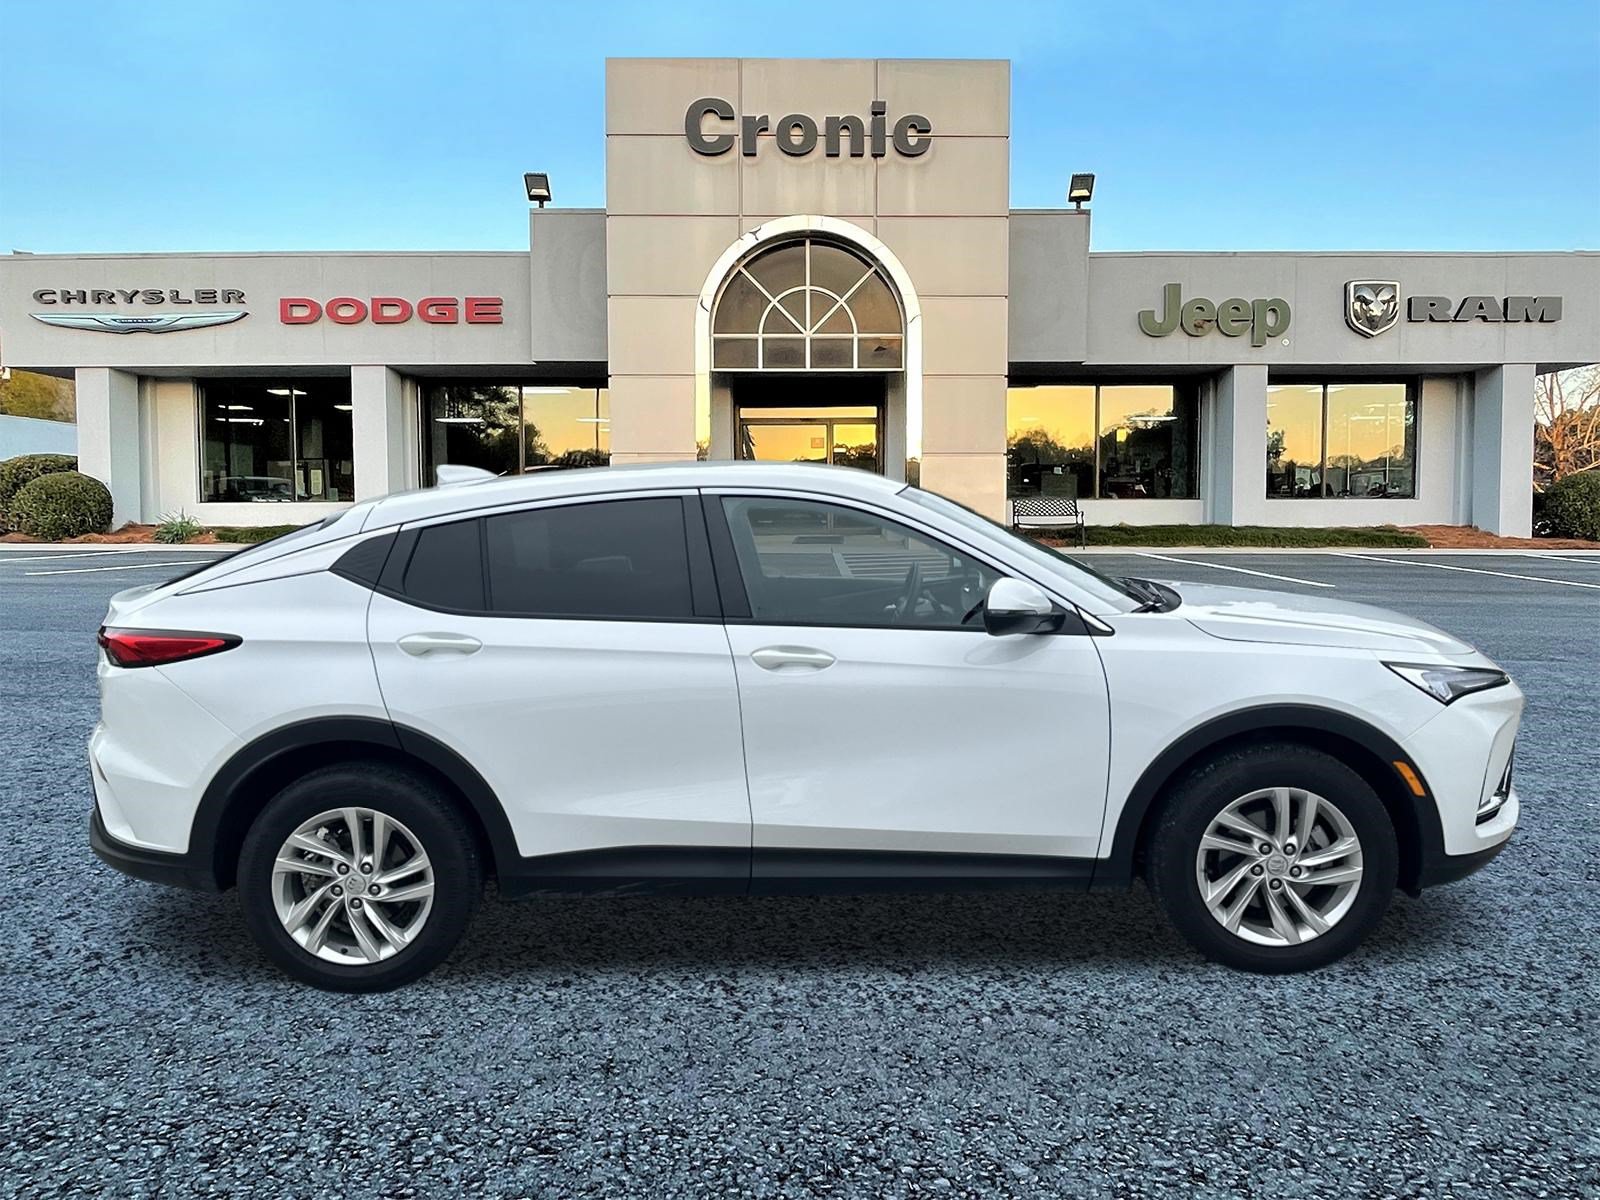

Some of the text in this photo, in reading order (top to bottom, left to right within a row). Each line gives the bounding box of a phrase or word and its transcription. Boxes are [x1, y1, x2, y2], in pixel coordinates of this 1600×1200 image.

[685, 97, 932, 157] Cronic
[32, 288, 246, 304] CHRYSLER
[1407, 296, 1563, 322] RAM
[280, 297, 504, 325] DODGE
[1138, 283, 1292, 347] Jeep
